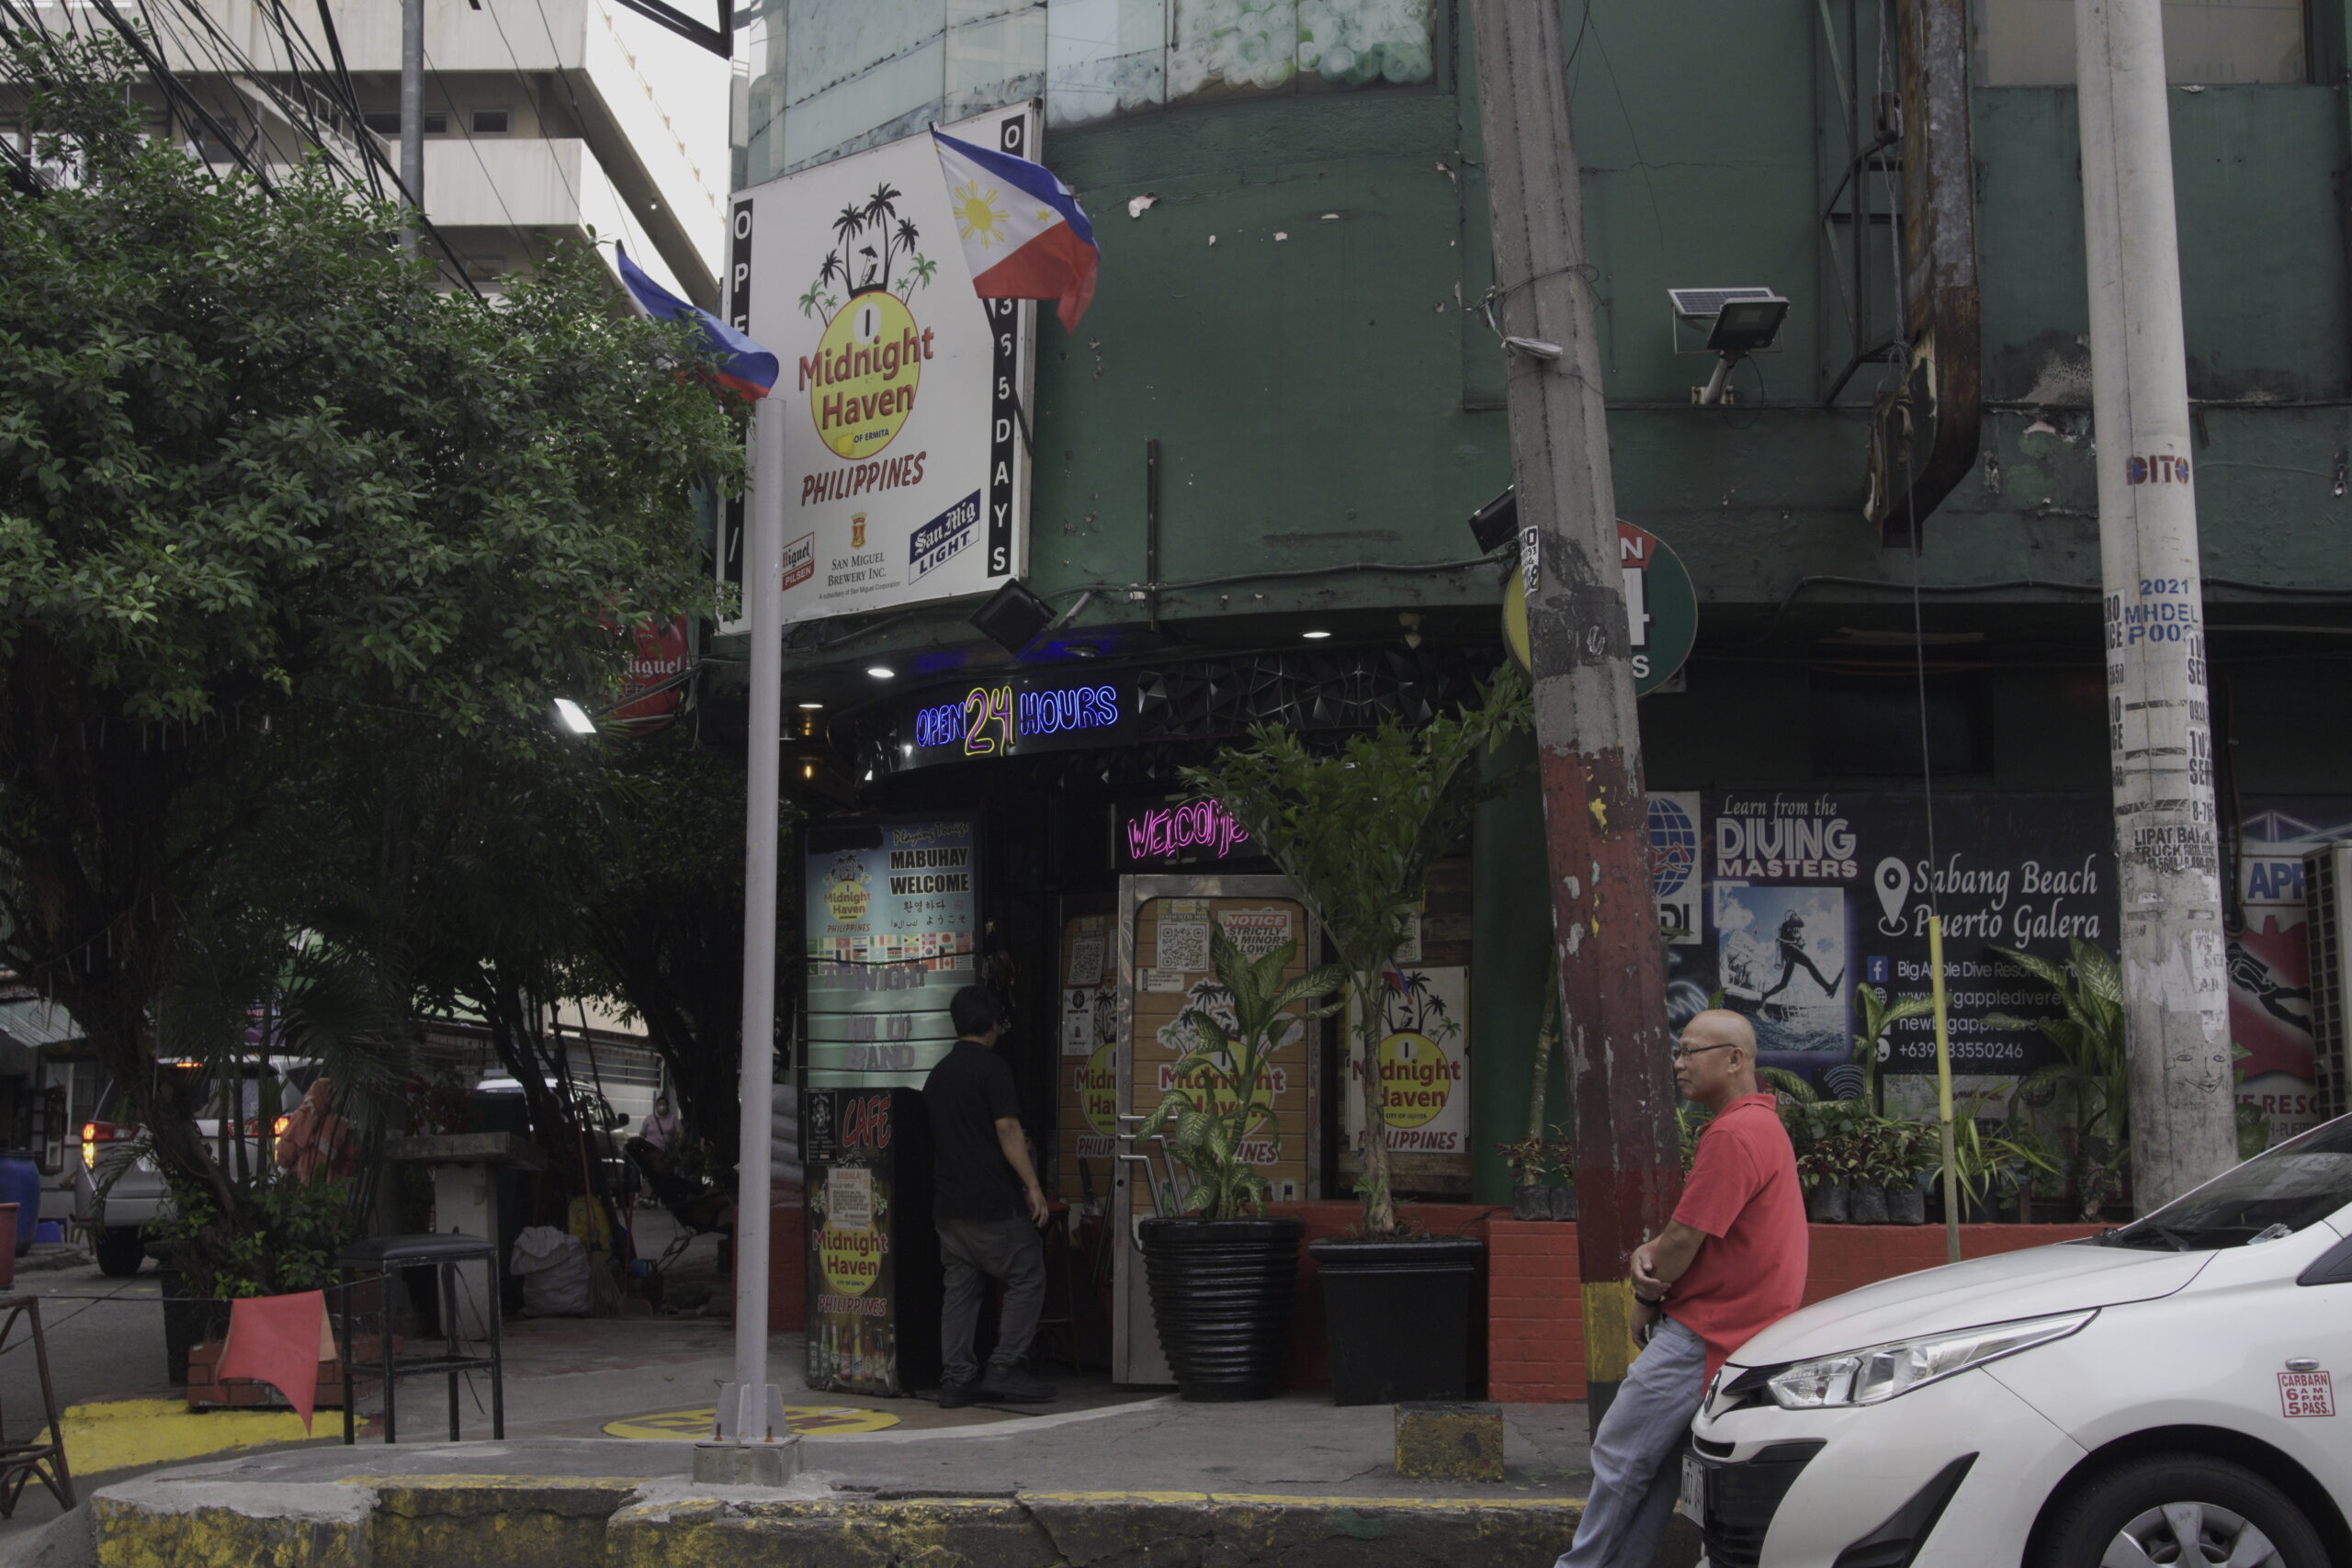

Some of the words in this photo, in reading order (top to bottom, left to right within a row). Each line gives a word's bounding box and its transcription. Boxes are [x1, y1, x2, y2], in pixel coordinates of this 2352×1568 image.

[798, 326, 934, 391] Midnight
[822, 384, 914, 430] Haven
[854, 434, 864, 444] OF
[865, 428, 890, 442] ERMITA
[801, 451, 927, 507] PHILIPPINES
[2125, 455, 2189, 486] DITO
[914, 530, 946, 557] San
[944, 502, 977, 542] Mig
[920, 530, 970, 574] LIGHT
[831, 558, 849, 571] SAN
[785, 565, 812, 586] PILSEN
[828, 570, 866, 587] BREWERY
[868, 568, 888, 581] INC.
[860, 584, 875, 595] Miguel
[875, 581, 901, 593] Corporation
[2141, 579, 2189, 595] 2021
[2124, 604, 2199, 625] MHDEL
[2128, 624, 2194, 645] P00
[916, 701, 967, 748] OPEN
[965, 685, 1015, 757] 24
[1020, 685, 1118, 735] HOURS
[1723, 795, 1768, 816] Learn
[1770, 793, 1809, 825] from
[1814, 793, 1838, 816] the
[892, 829, 936, 846] Playing
[1715, 818, 1857, 861] DIVING
[2135, 827, 2173, 846] LIPAT
[891, 848, 968, 870] MABUHAY
[1717, 860, 1858, 877] MASTERS
[890, 874, 970, 896] WELCOME
[1913, 852, 2010, 910] Sabang
[2021, 853, 2098, 894] Beach
[824, 891, 871, 904] Midnight
[832, 904, 865, 915] Haven
[827, 923, 871, 933] PHILIPPINES
[1226, 915, 1285, 926] NOTICE
[1913, 904, 2003, 938] Puerto
[2014, 897, 2100, 949] Galera
[1241, 935, 1288, 945] MINORS
[819, 964, 928, 991] TONIGHT
[1897, 961, 1919, 981] Big
[1963, 960, 1994, 977] Dive
[845, 1045, 915, 1070] BAND
[1899, 1042, 2023, 1059] +63983550246
[1076, 1069, 1116, 1090] Midn
[1352, 1058, 1461, 1087] Mdnight
[842, 1095, 891, 1148] CAFE
[812, 1230, 888, 1257] Midnight
[827, 1255, 878, 1276] Haven
[818, 1294, 887, 1316] PHILIPPINES
[2281, 1373, 2328, 1387] CARBARN
[2286, 1388, 2299, 1401] 6
[2289, 1402, 2301, 1415] 5
[2302, 1401, 2330, 1415] PASS.
